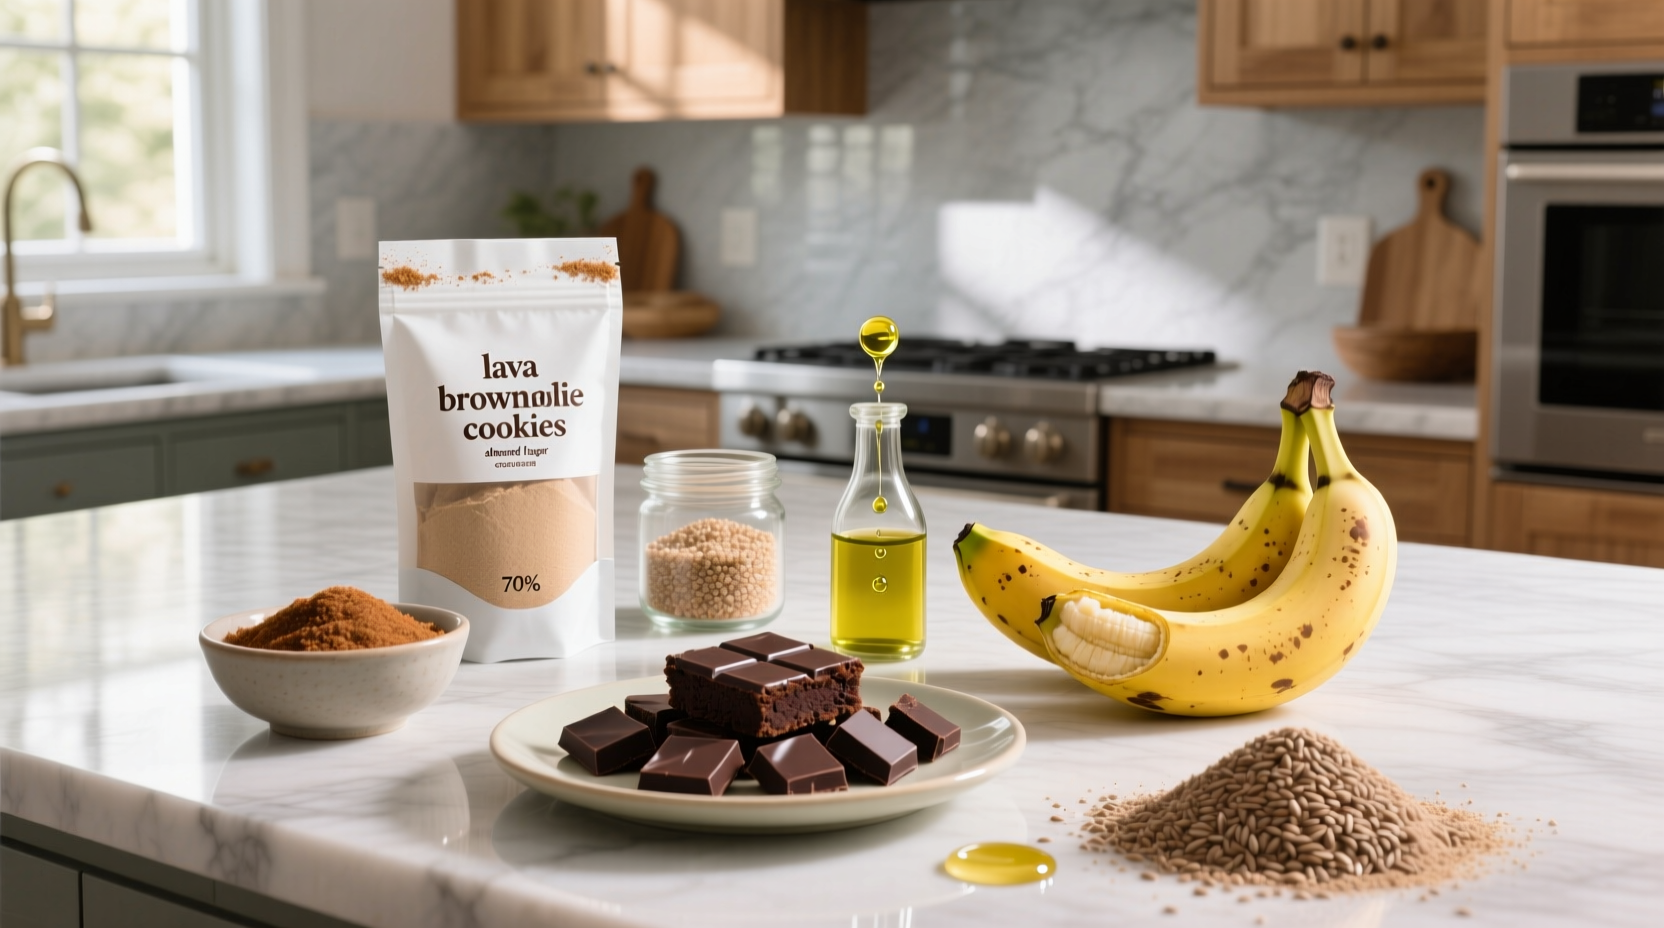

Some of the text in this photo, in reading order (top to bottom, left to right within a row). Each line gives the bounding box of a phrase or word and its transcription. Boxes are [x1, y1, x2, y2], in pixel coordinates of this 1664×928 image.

[480, 352, 539, 379] lava
[463, 413, 567, 441] cookies
[501, 574, 541, 593] 70%
